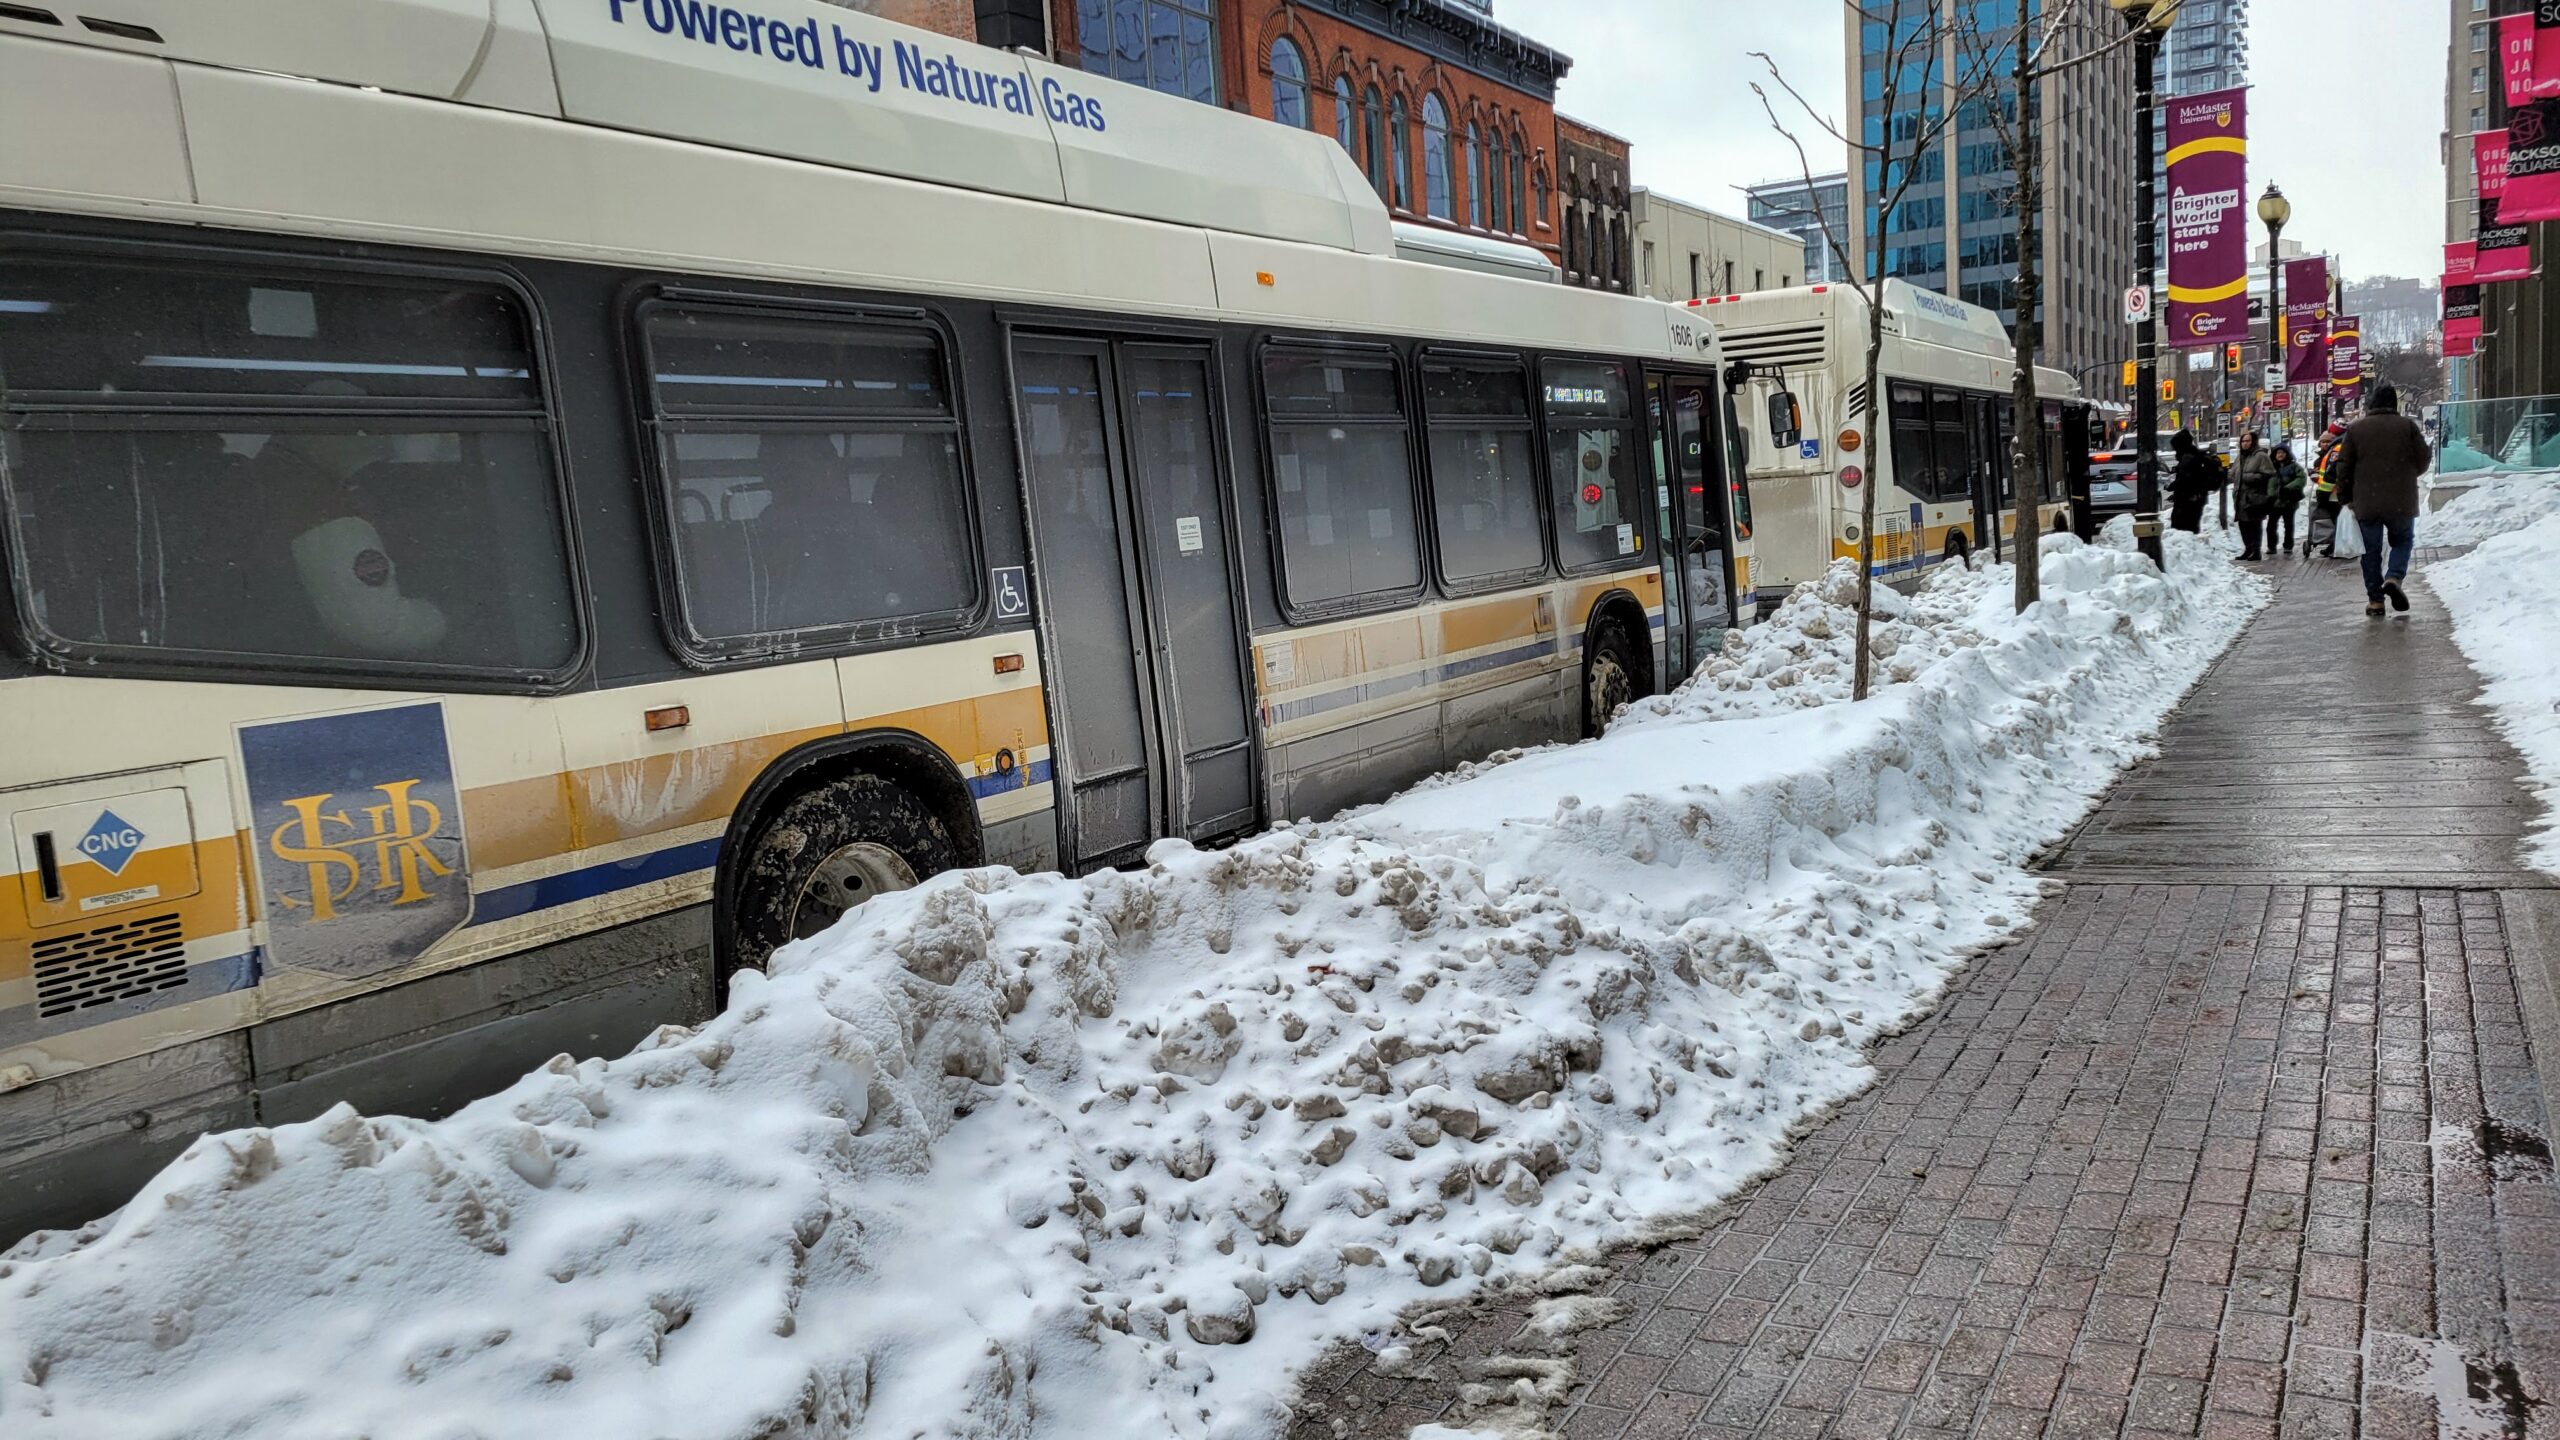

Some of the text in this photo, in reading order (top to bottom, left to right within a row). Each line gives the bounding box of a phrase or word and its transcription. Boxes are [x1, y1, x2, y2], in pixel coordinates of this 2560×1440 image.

[832, 24, 882, 93] by
[893, 39, 1034, 117] Natural
[1041, 77, 1106, 132] Gas
[2179, 102, 2232, 118] McMaster
[2180, 113, 2215, 125] University
[2173, 186, 2185, 197] A
[2174, 193, 2237, 211] Brighter
[2174, 208, 2220, 225] World
[2174, 224, 2220, 239] starts
[2478, 226, 2527, 240] JACKSON
[2174, 240, 2209, 253] here
[2478, 237, 2521, 249] SQUARE
[2288, 302, 2326, 313] McMaster
[2447, 304, 2479, 313] JACKSON
[2196, 316, 2227, 327] Brighter
[2447, 311, 2474, 319] SQUARE
[2197, 323, 2218, 331] World
[1671, 323, 1693, 346] 1606
[1545, 385, 1553, 402] 2
[83, 828, 138, 854] CNG
